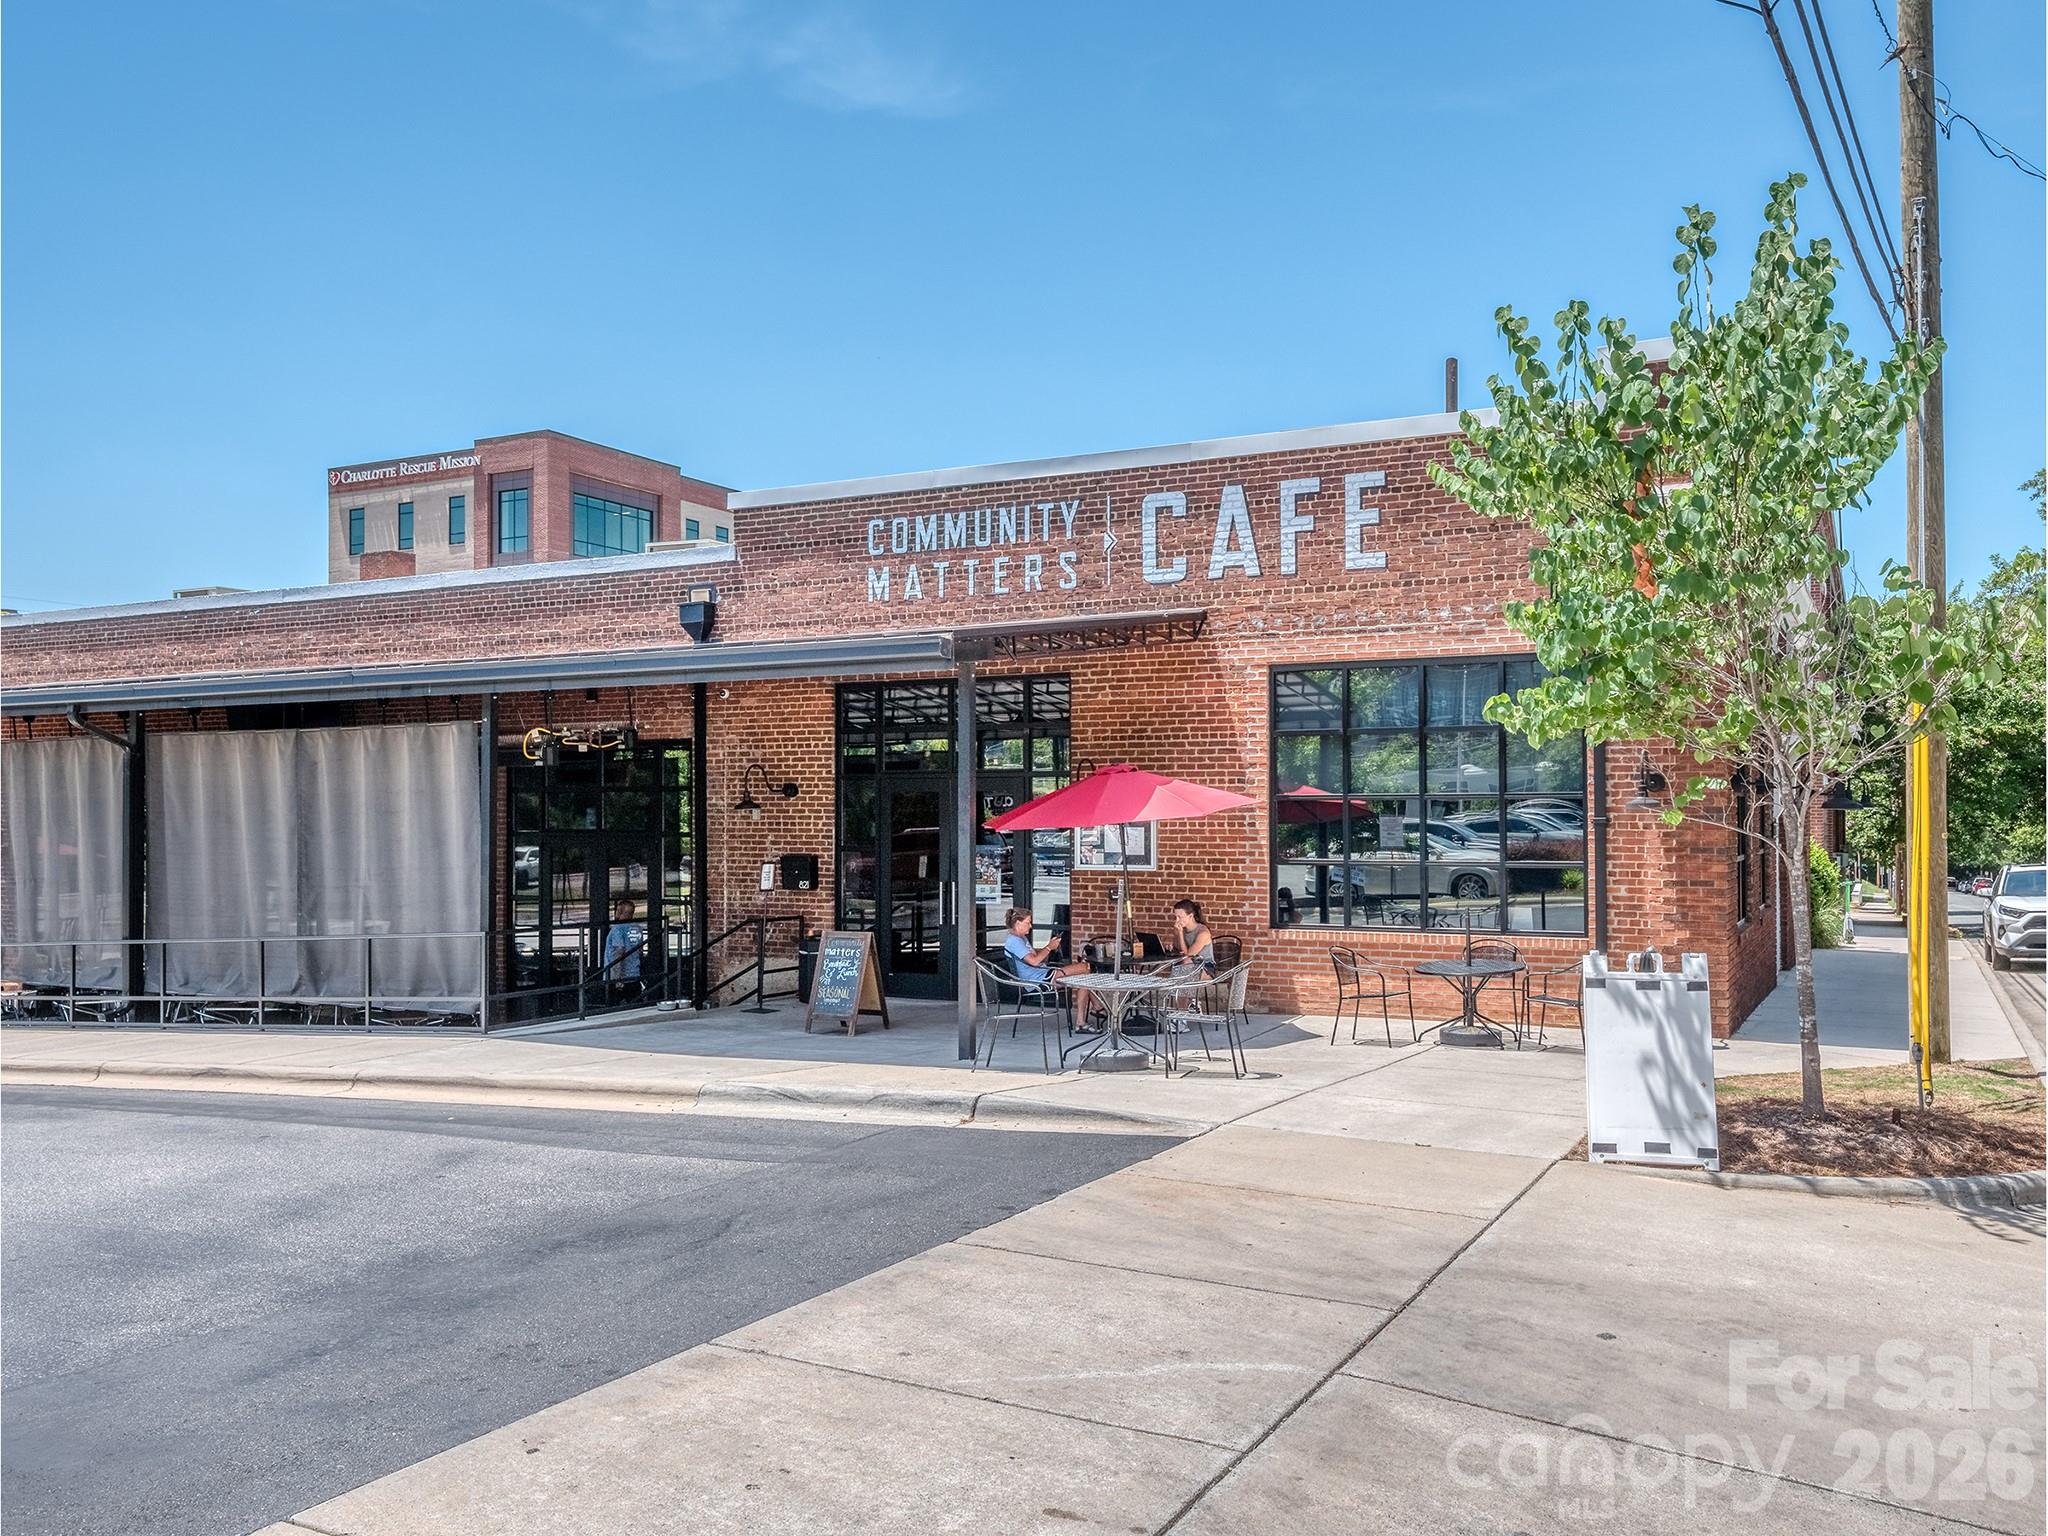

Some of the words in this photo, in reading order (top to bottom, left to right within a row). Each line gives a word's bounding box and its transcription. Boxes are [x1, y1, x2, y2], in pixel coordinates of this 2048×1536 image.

[341, 466, 397, 484] CHARLOTTE
[399, 461, 437, 476] RESCUE
[439, 455, 482, 471] MISSION
[867, 499, 1080, 557] COMMUNITY
[1141, 470, 1388, 585] CAFE
[867, 550, 1077, 603] MATTERS
[824, 948, 861, 957] matters
